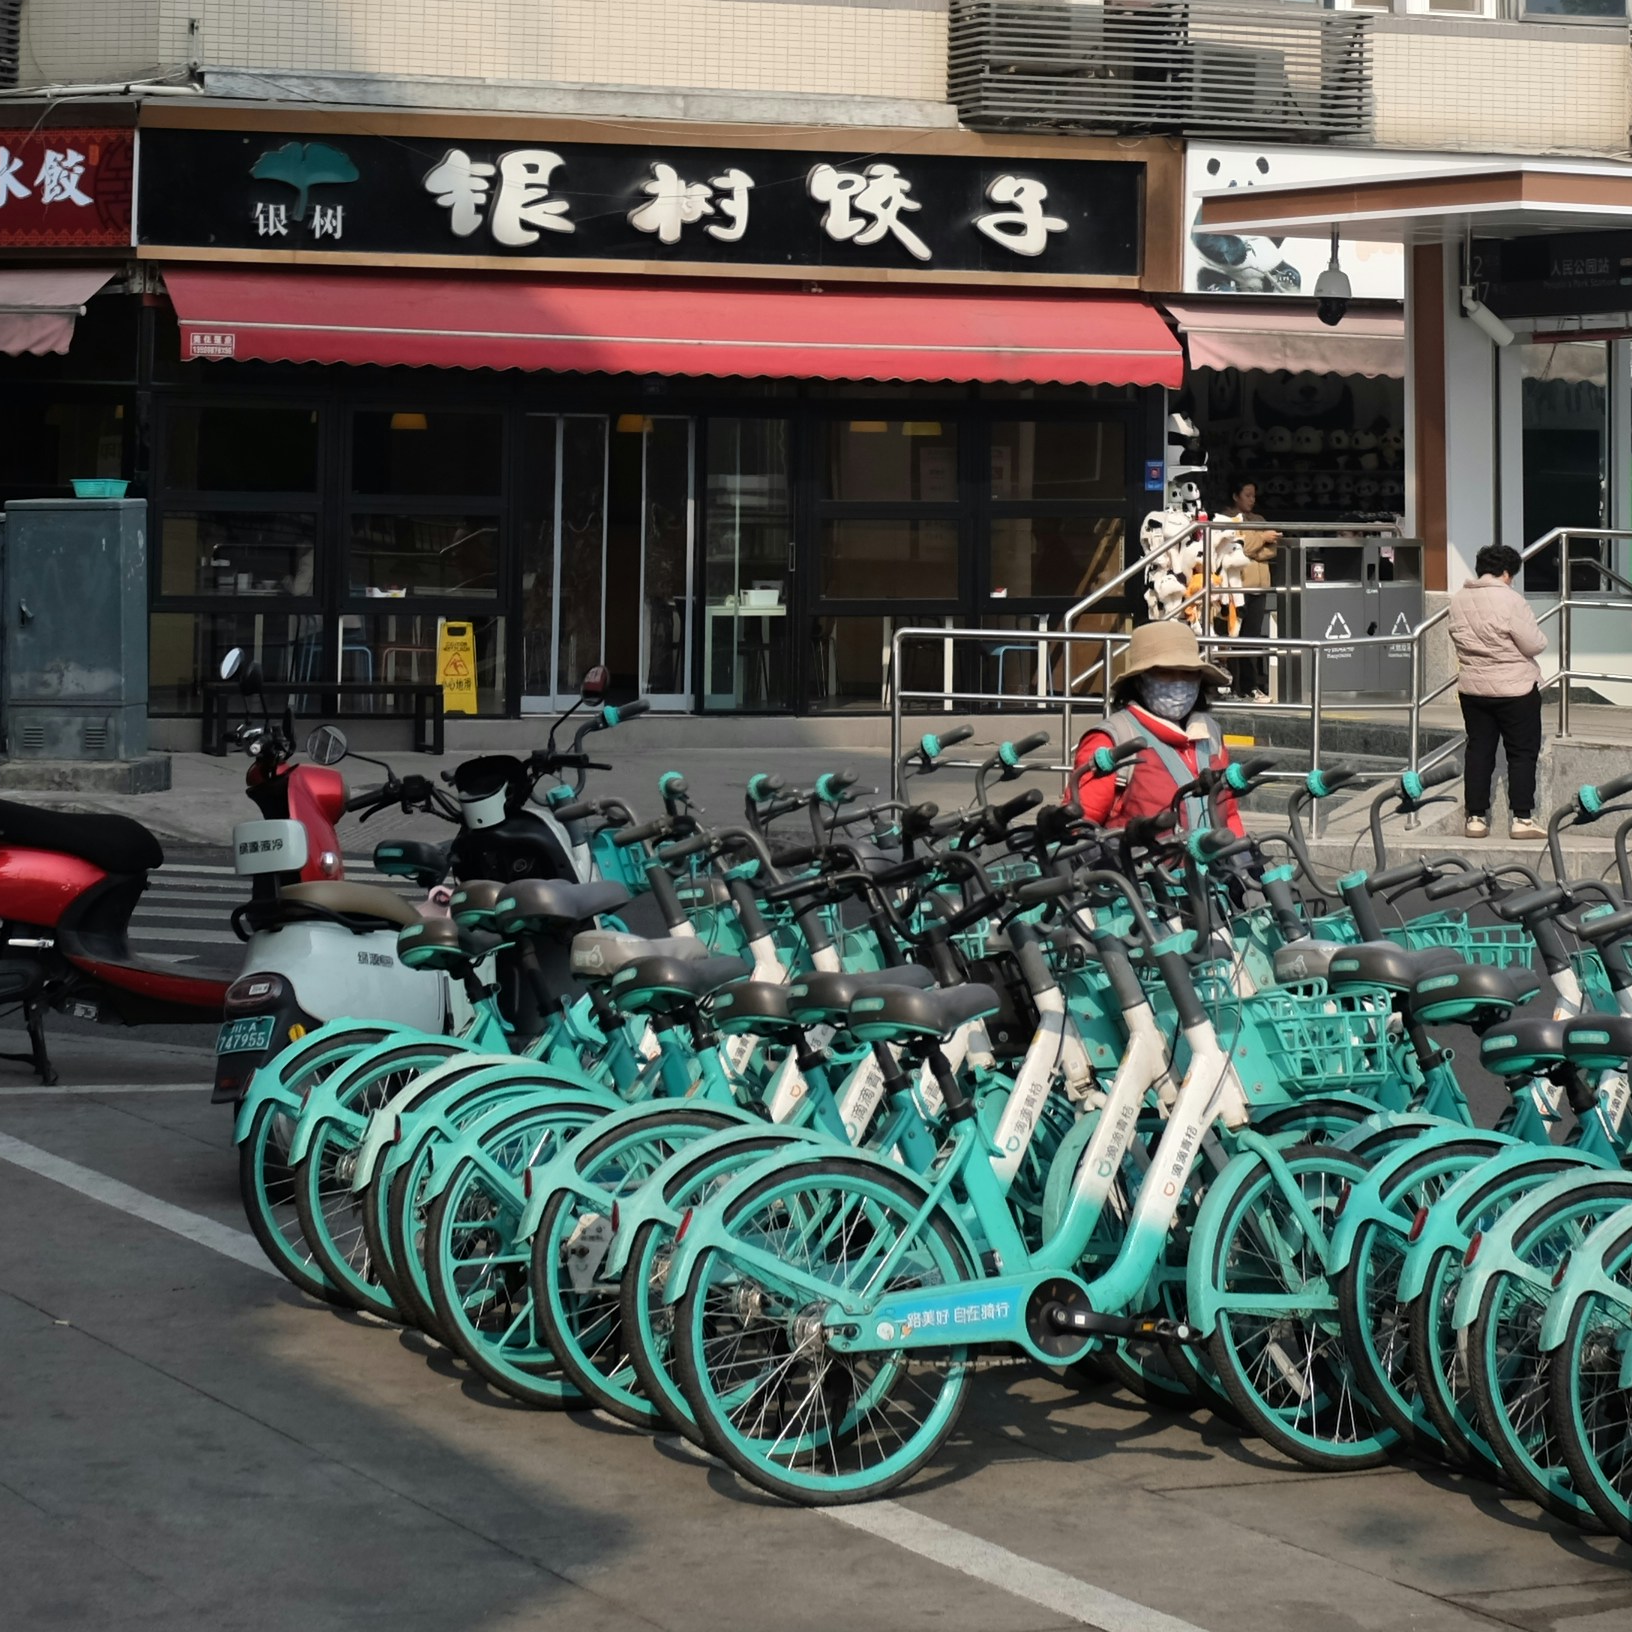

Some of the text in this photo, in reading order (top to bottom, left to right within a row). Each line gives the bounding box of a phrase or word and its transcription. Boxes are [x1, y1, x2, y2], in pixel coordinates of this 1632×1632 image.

[252, 200, 346, 241] 银树
[1472, 255, 1484, 278] 2
[1549, 258, 1611, 277] 人民公园站
[218, 1032, 267, 1052] 747955
[1013, 1080, 1044, 1136] 滴滴青桔
[1105, 1105, 1136, 1162] 滴滴青桔
[1170, 1124, 1198, 1180] 滴滴青桔
[894, 1301, 1011, 1328] 一路美好 自在骑行
